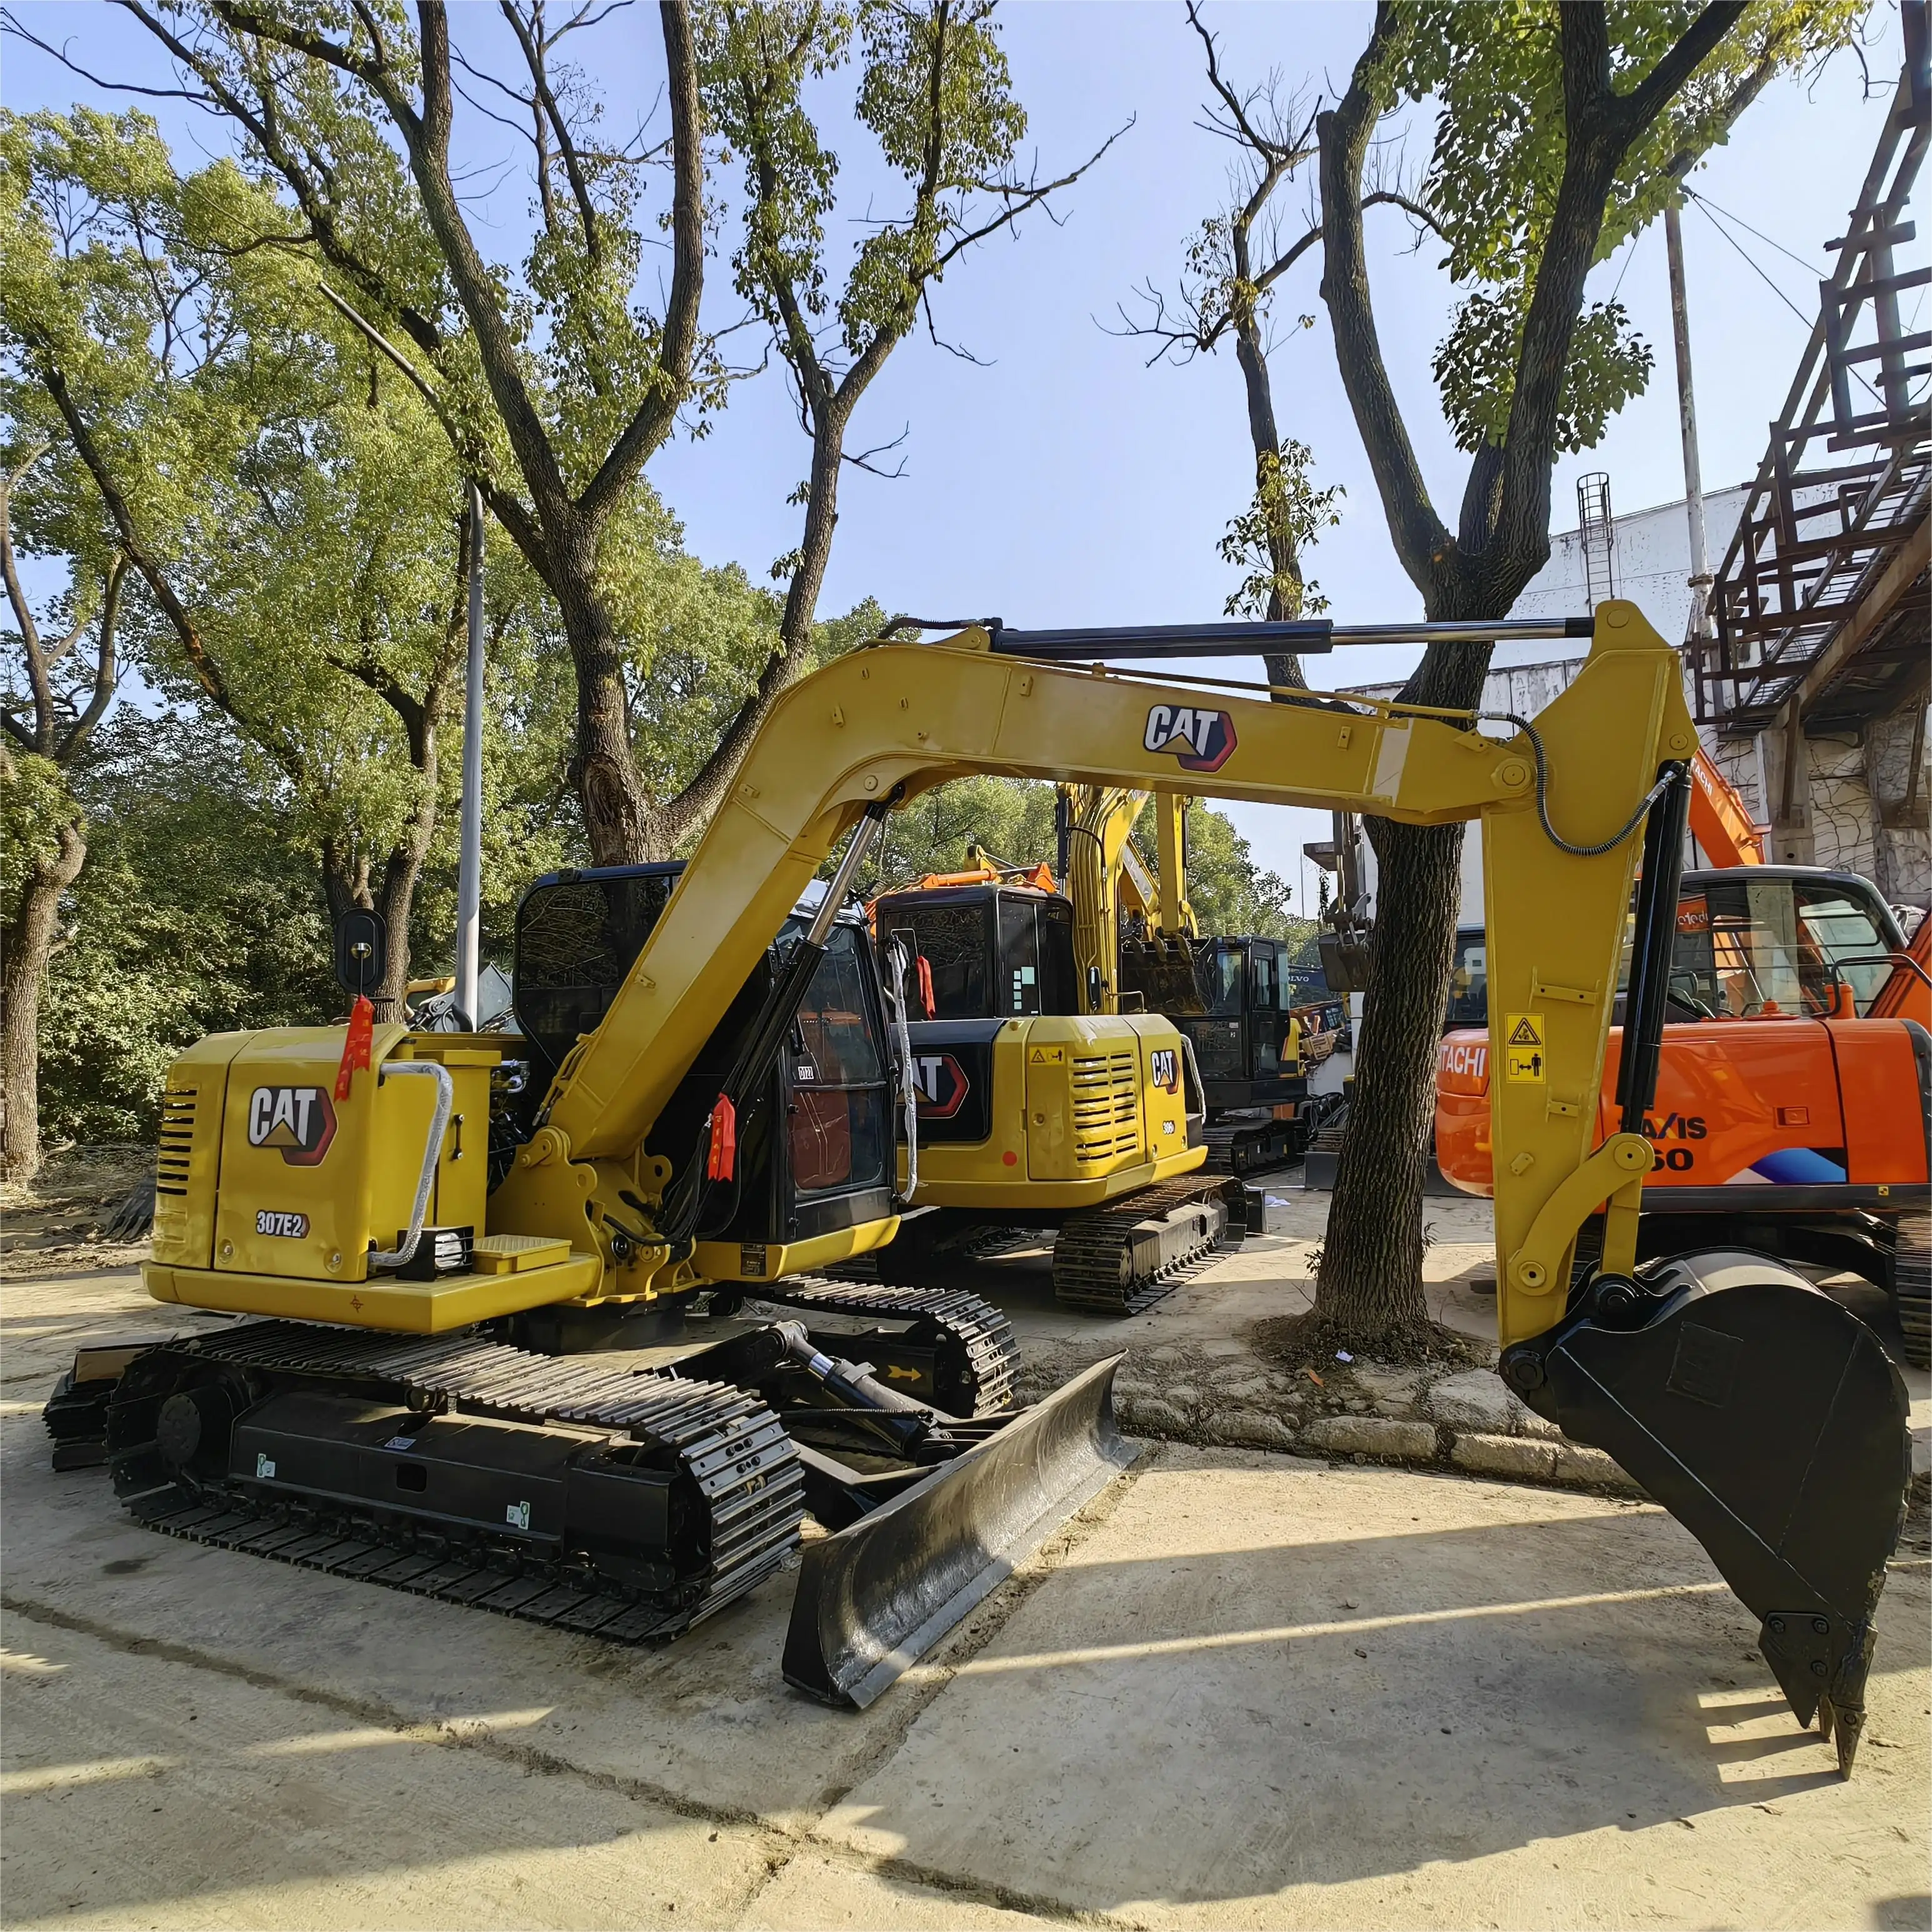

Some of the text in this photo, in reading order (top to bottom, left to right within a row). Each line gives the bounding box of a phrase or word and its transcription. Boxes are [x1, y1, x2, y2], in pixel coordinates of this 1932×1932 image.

[1145, 705, 1219, 756] CAT
[900, 1056, 942, 1102] AT
[1151, 1051, 1173, 1086] CAT
[249, 1088, 317, 1146] CAT
[1641, 1112, 1708, 1139] AXIS
[257, 1211, 302, 1237] 307E2
